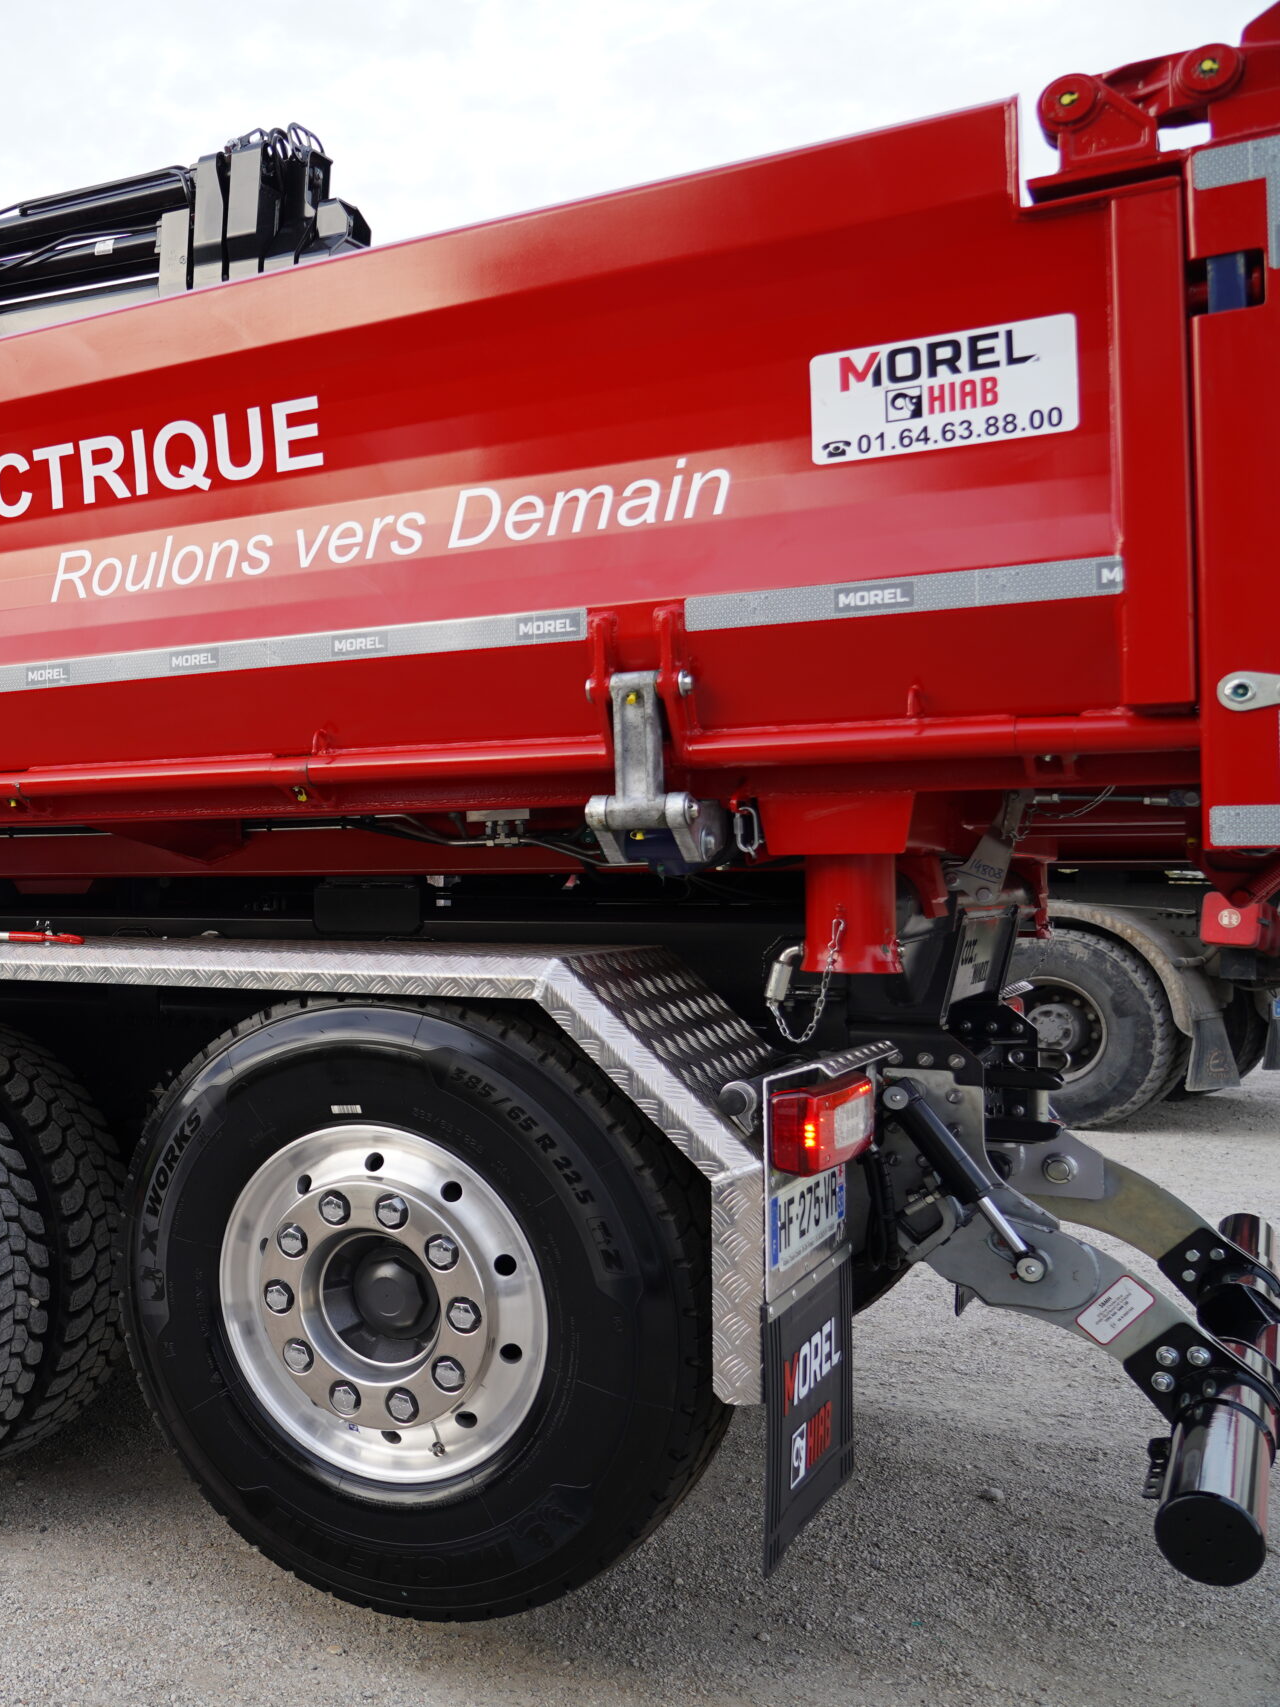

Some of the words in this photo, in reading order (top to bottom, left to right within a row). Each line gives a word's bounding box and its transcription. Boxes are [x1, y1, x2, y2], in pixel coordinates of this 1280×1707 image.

[839, 329, 1039, 392] MOREL
[927, 376, 999, 415] HIAB
[857, 406, 1063, 454] 01.64.63.88.00
[50, 533, 273, 603] Roulons
[295, 510, 426, 568] vers
[447, 458, 730, 548] Demain
[838, 588, 910, 608] MOREL
[333, 636, 386, 653] MOREL
[518, 617, 577, 636] MOREL
[27, 667, 68, 683] MOREL
[171, 653, 218, 670] MOREL
[450, 1066, 539, 1133] 385/65
[534, 1132, 557, 1154] R
[552, 1156, 596, 1207] 22.5
[145, 1106, 201, 1218] WORKS
[784, 1317, 842, 1417] MOREL
[807, 1400, 832, 1469] HIAB
